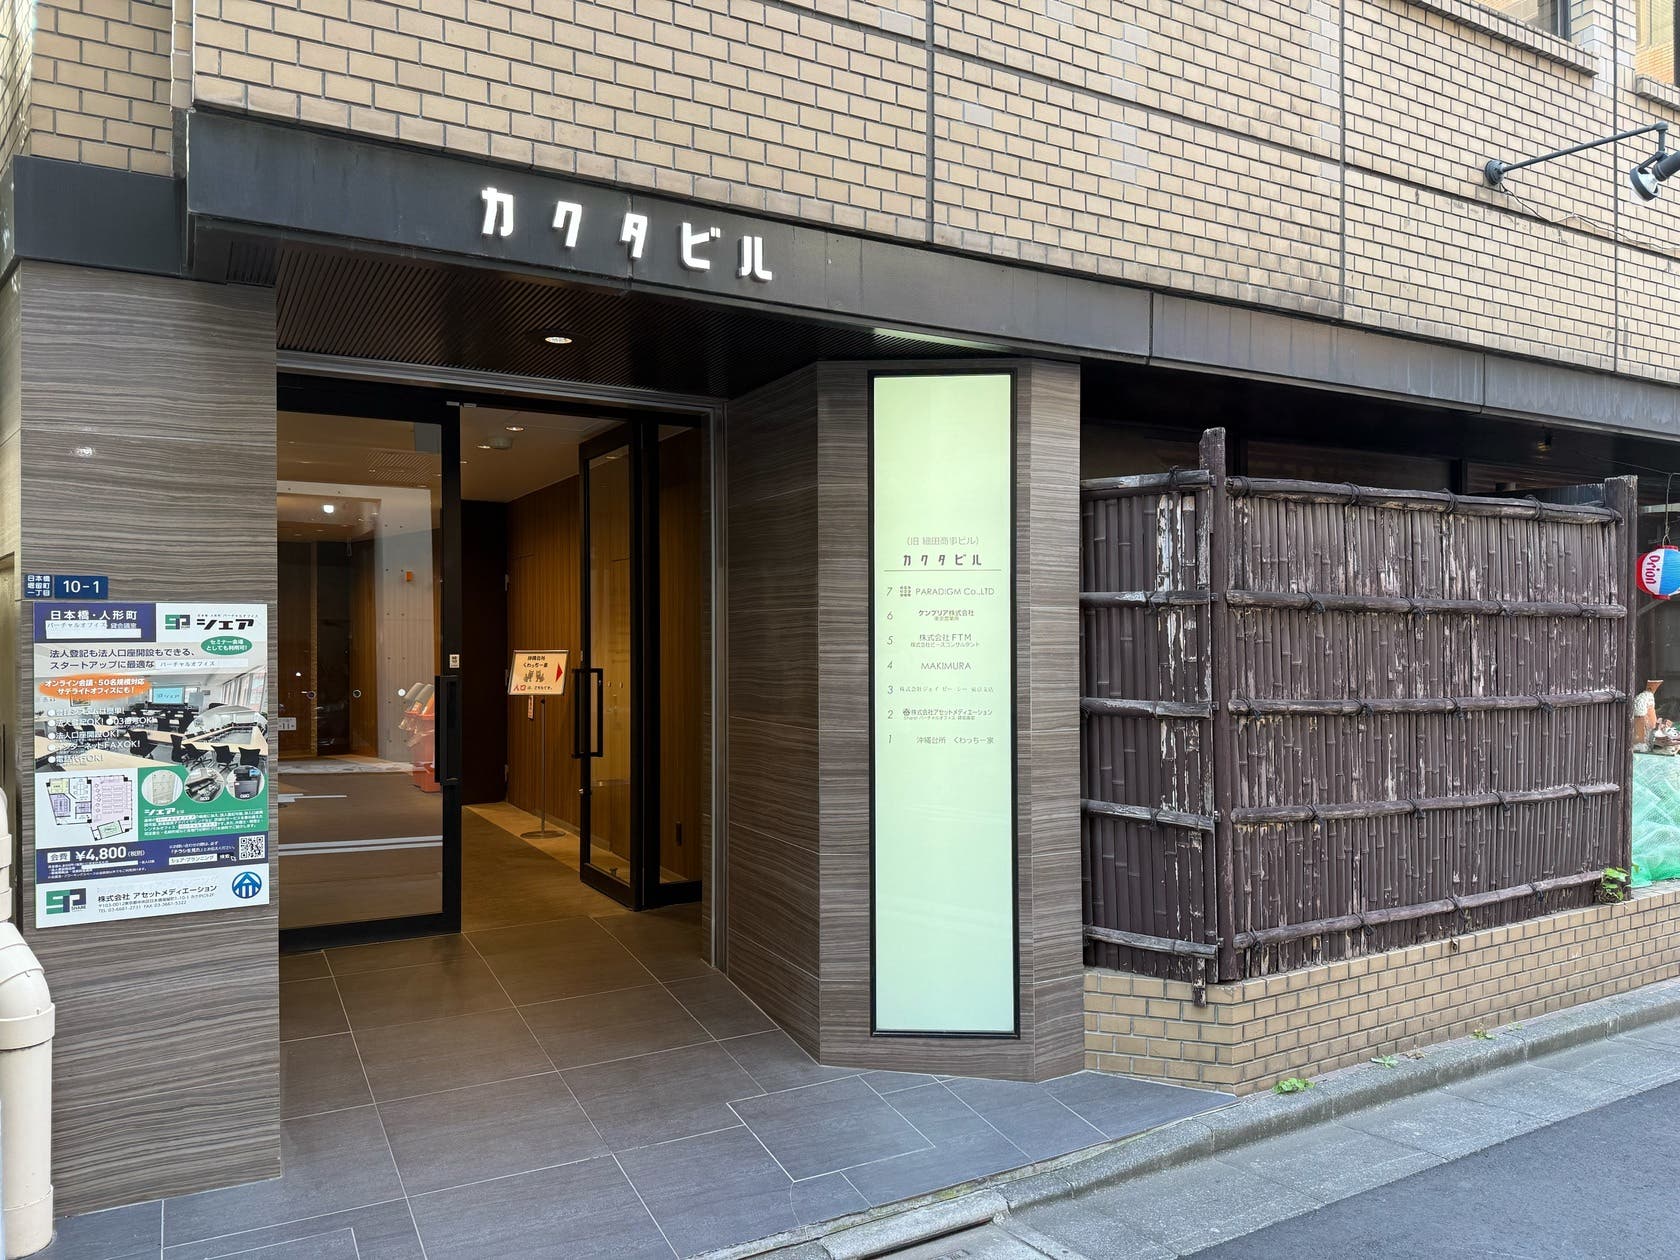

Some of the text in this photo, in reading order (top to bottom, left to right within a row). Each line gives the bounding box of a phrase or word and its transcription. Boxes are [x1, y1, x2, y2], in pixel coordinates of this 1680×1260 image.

[481, 187, 773, 282] カクタビル
[903, 554, 982, 566] カクタビル
[1645, 555, 1661, 584] Orion
[63, 580, 100, 593] 10-1
[886, 587, 893, 596] 7
[50, 610, 138, 620] 日本橋・人形町
[886, 611, 893, 620] 6
[196, 618, 254, 630] シェア
[887, 636, 893, 645] 5
[49, 648, 195, 659] 法人登記も法人口座開設もできる、
[50, 660, 155, 670] スタートアップに最適な
[887, 661, 893, 669] 4
[920, 662, 971, 670] MAKIMURA
[887, 685, 893, 694] 3
[887, 710, 893, 719] 2
[144, 808, 176, 816] シェア
[98, 893, 130, 902] 株式会社
[133, 885, 217, 899] アセットメディエーション
